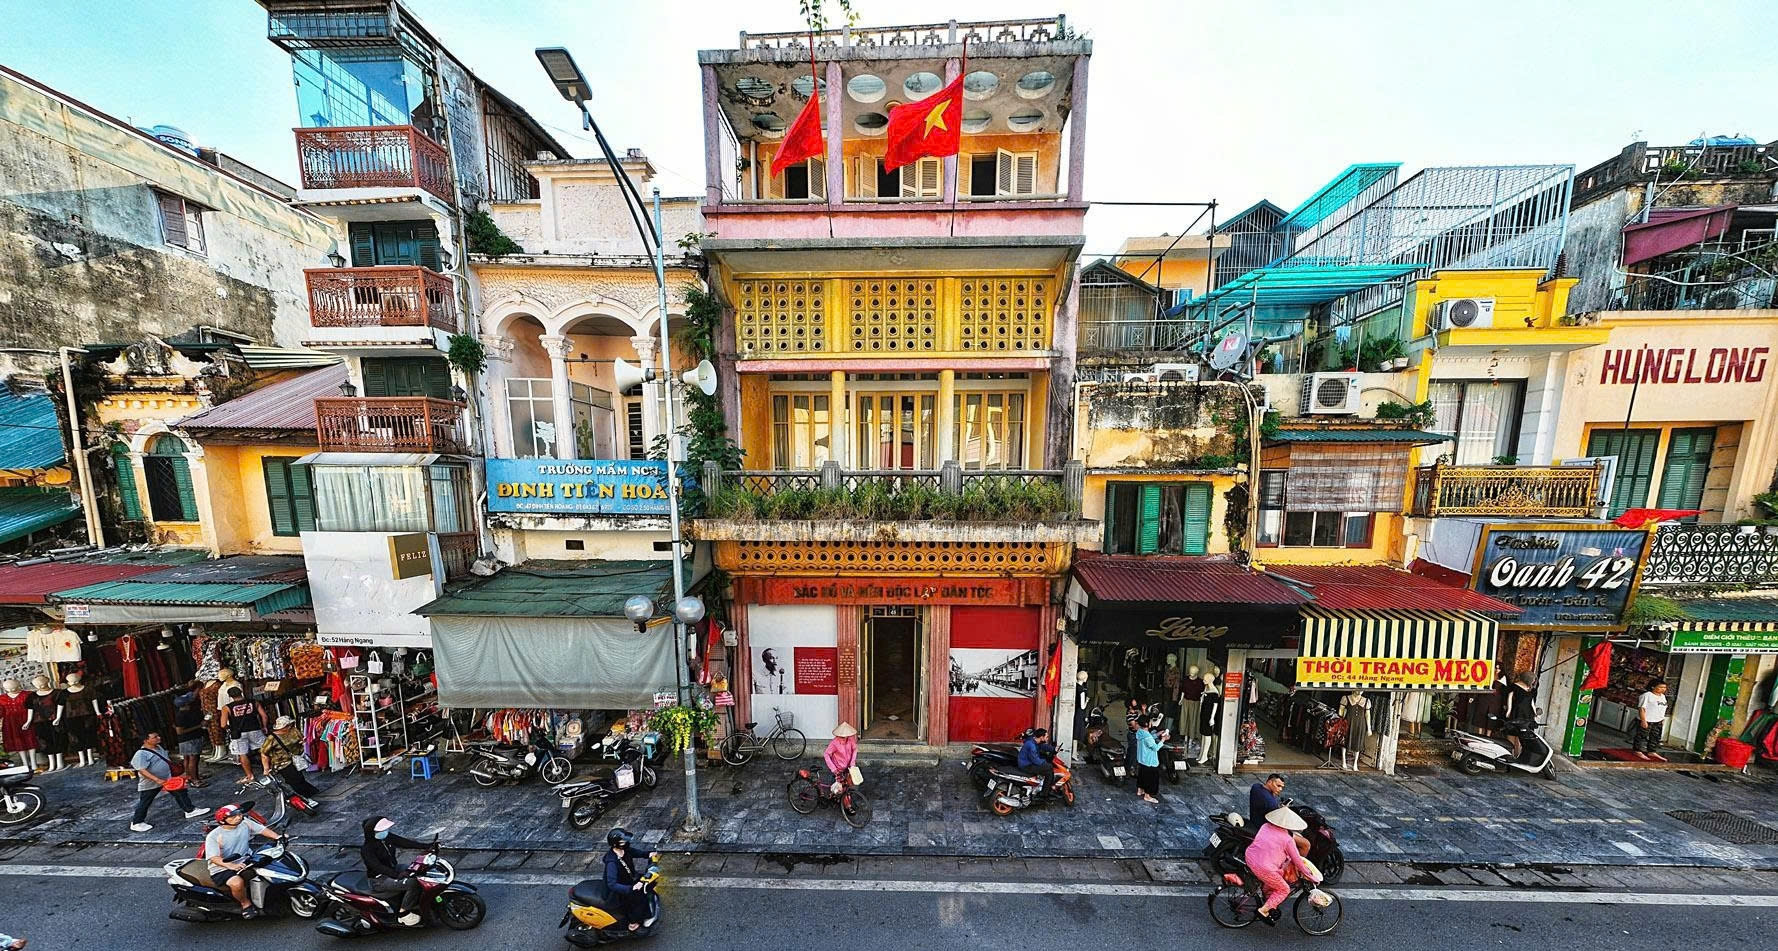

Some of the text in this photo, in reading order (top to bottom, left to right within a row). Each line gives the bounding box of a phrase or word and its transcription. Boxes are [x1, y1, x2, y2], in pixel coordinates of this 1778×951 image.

[498, 483, 554, 498] ĐINH
[562, 479, 614, 499] TIÊN
[400, 551, 427, 561] FELIZ
[1490, 556, 1635, 589] Oanh 42
[1303, 657, 1352, 674] THỜI
[1359, 661, 1429, 675] TRANG
